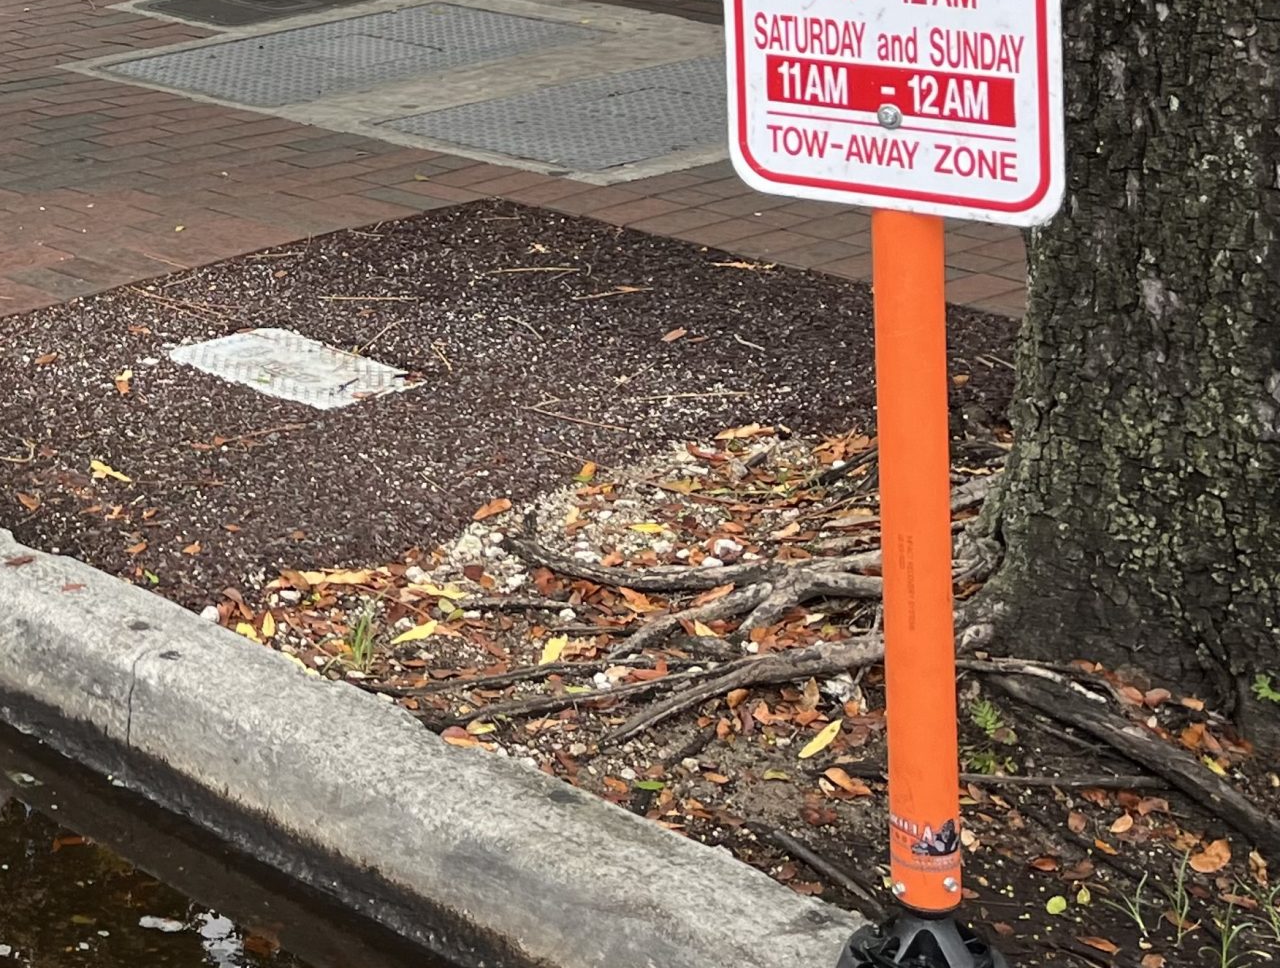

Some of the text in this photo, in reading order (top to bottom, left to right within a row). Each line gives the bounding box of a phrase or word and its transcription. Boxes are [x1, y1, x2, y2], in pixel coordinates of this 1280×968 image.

[754, 11, 1024, 73] SATURDAY and SUNDAY
[777, 60, 848, 106] 11AM
[767, 124, 1018, 182] TOW-AWAY ZONE
